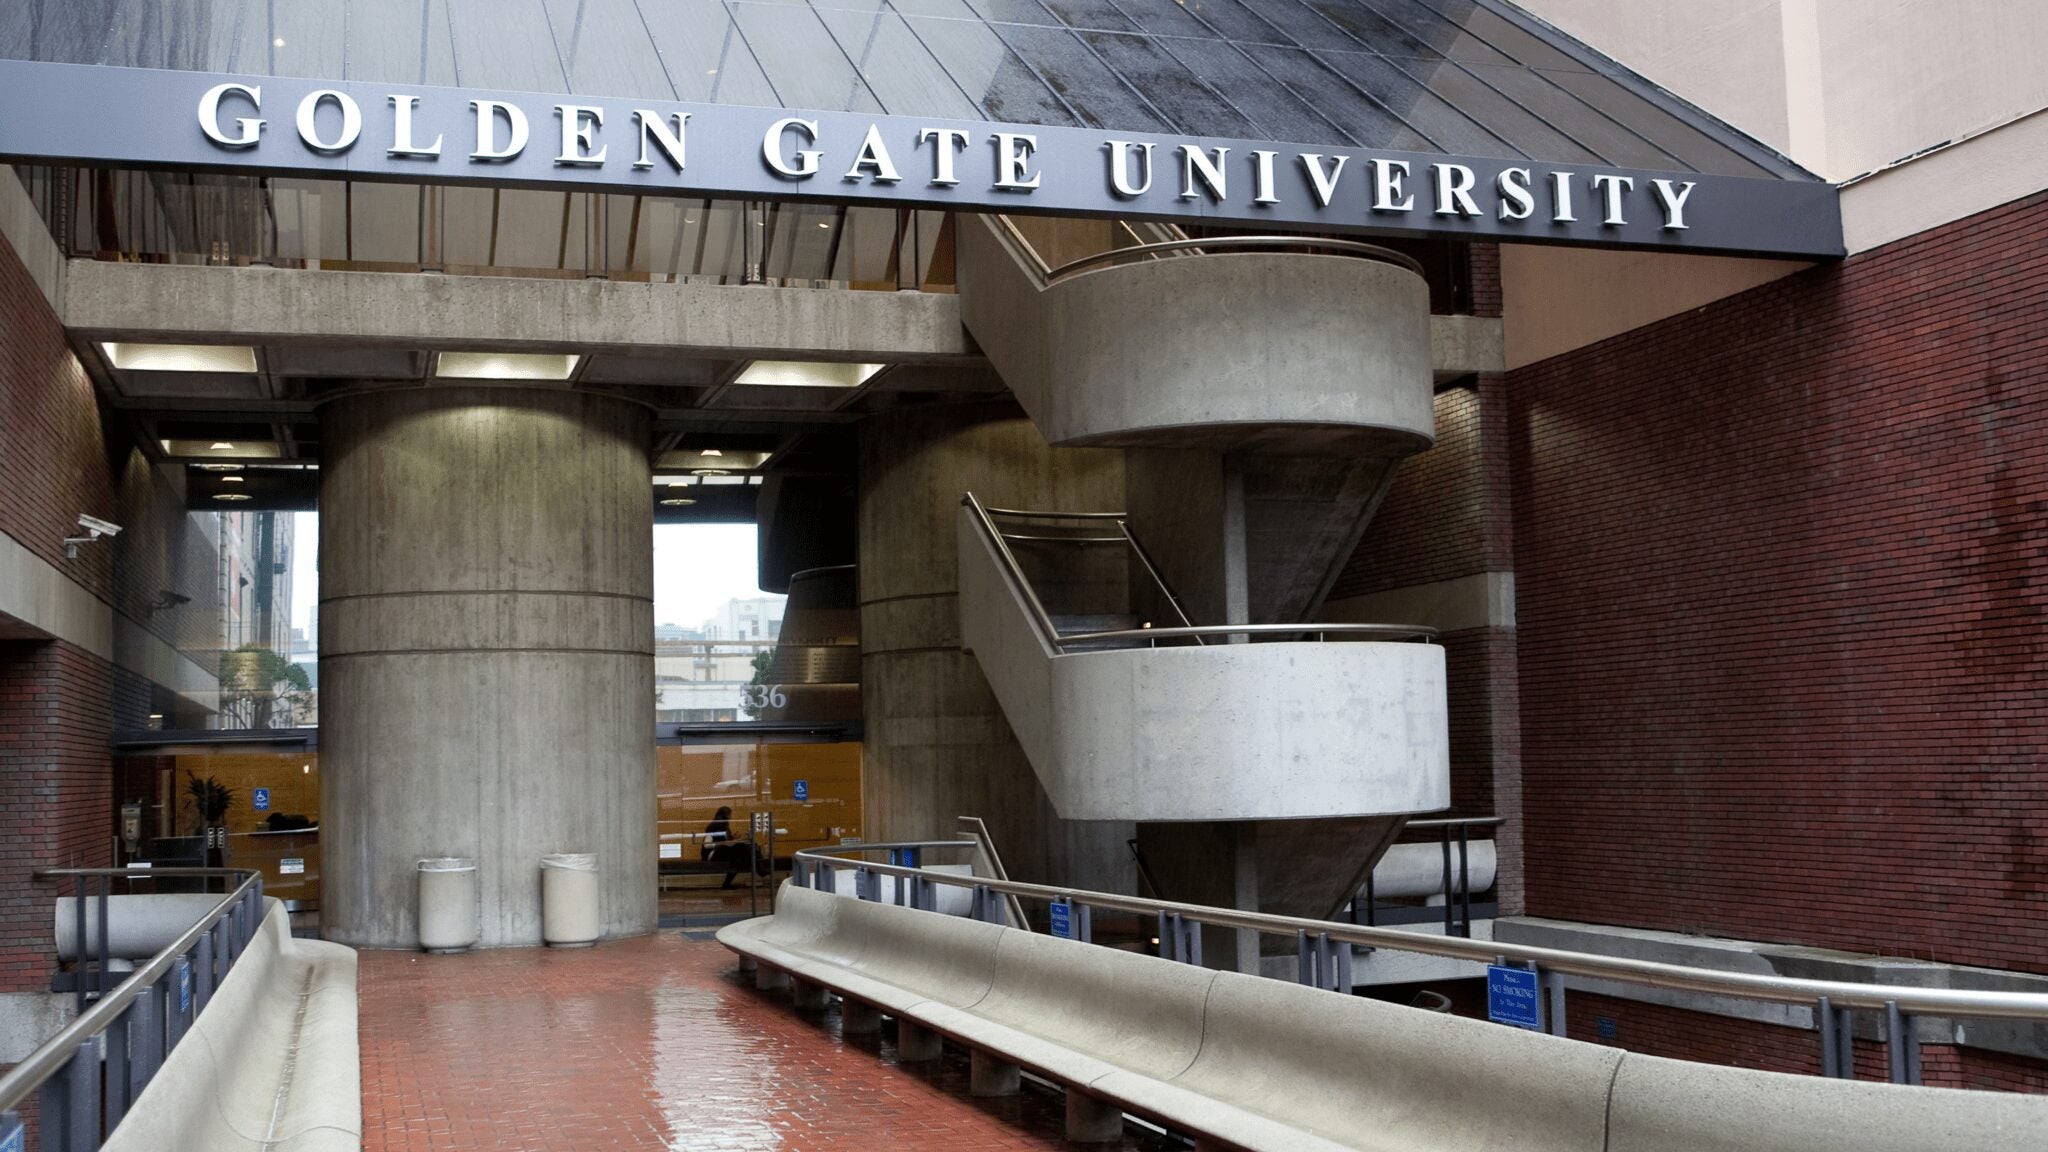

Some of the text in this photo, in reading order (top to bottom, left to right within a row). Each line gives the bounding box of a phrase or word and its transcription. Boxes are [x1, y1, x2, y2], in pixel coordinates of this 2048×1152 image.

[198, 83, 1698, 231] GOLDEN GATE UNIVERSITY
[740, 683, 787, 708] 536
